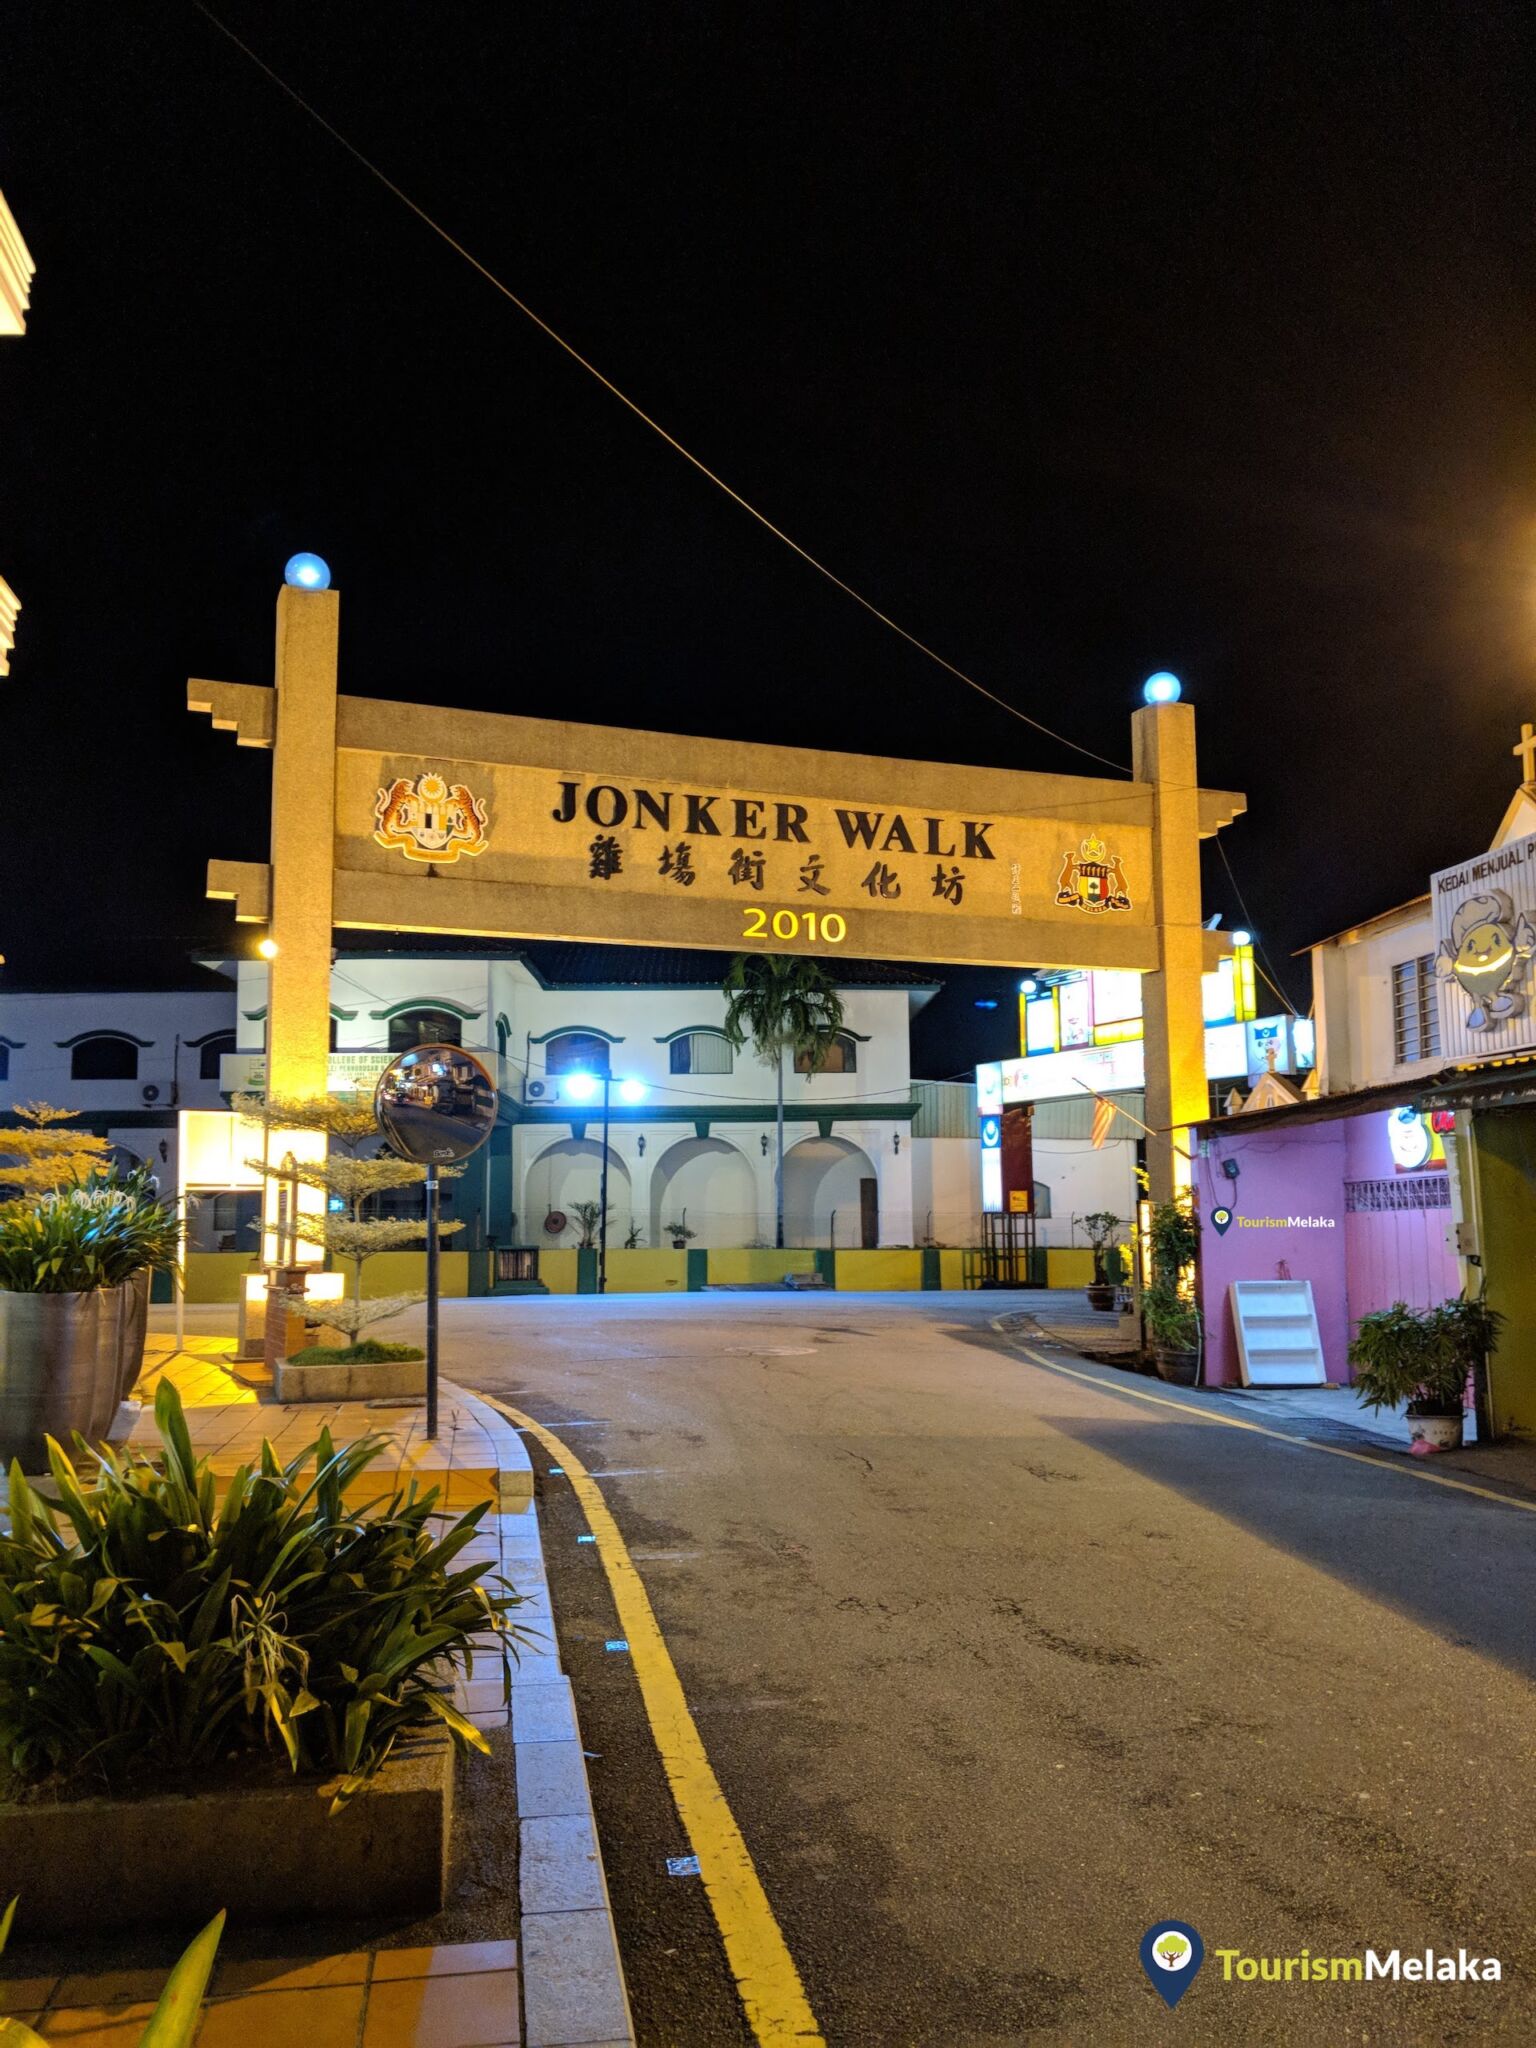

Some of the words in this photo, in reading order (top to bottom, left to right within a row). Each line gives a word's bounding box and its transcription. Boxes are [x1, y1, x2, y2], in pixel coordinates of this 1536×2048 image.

[552, 781, 810, 843] JONKER
[834, 808, 996, 860] WALK
[1438, 870, 1470, 894] KEDAI
[1472, 848, 1524, 882] MENJUAL
[742, 907, 847, 943] 2010
[359, 1056, 369, 1064] OF
